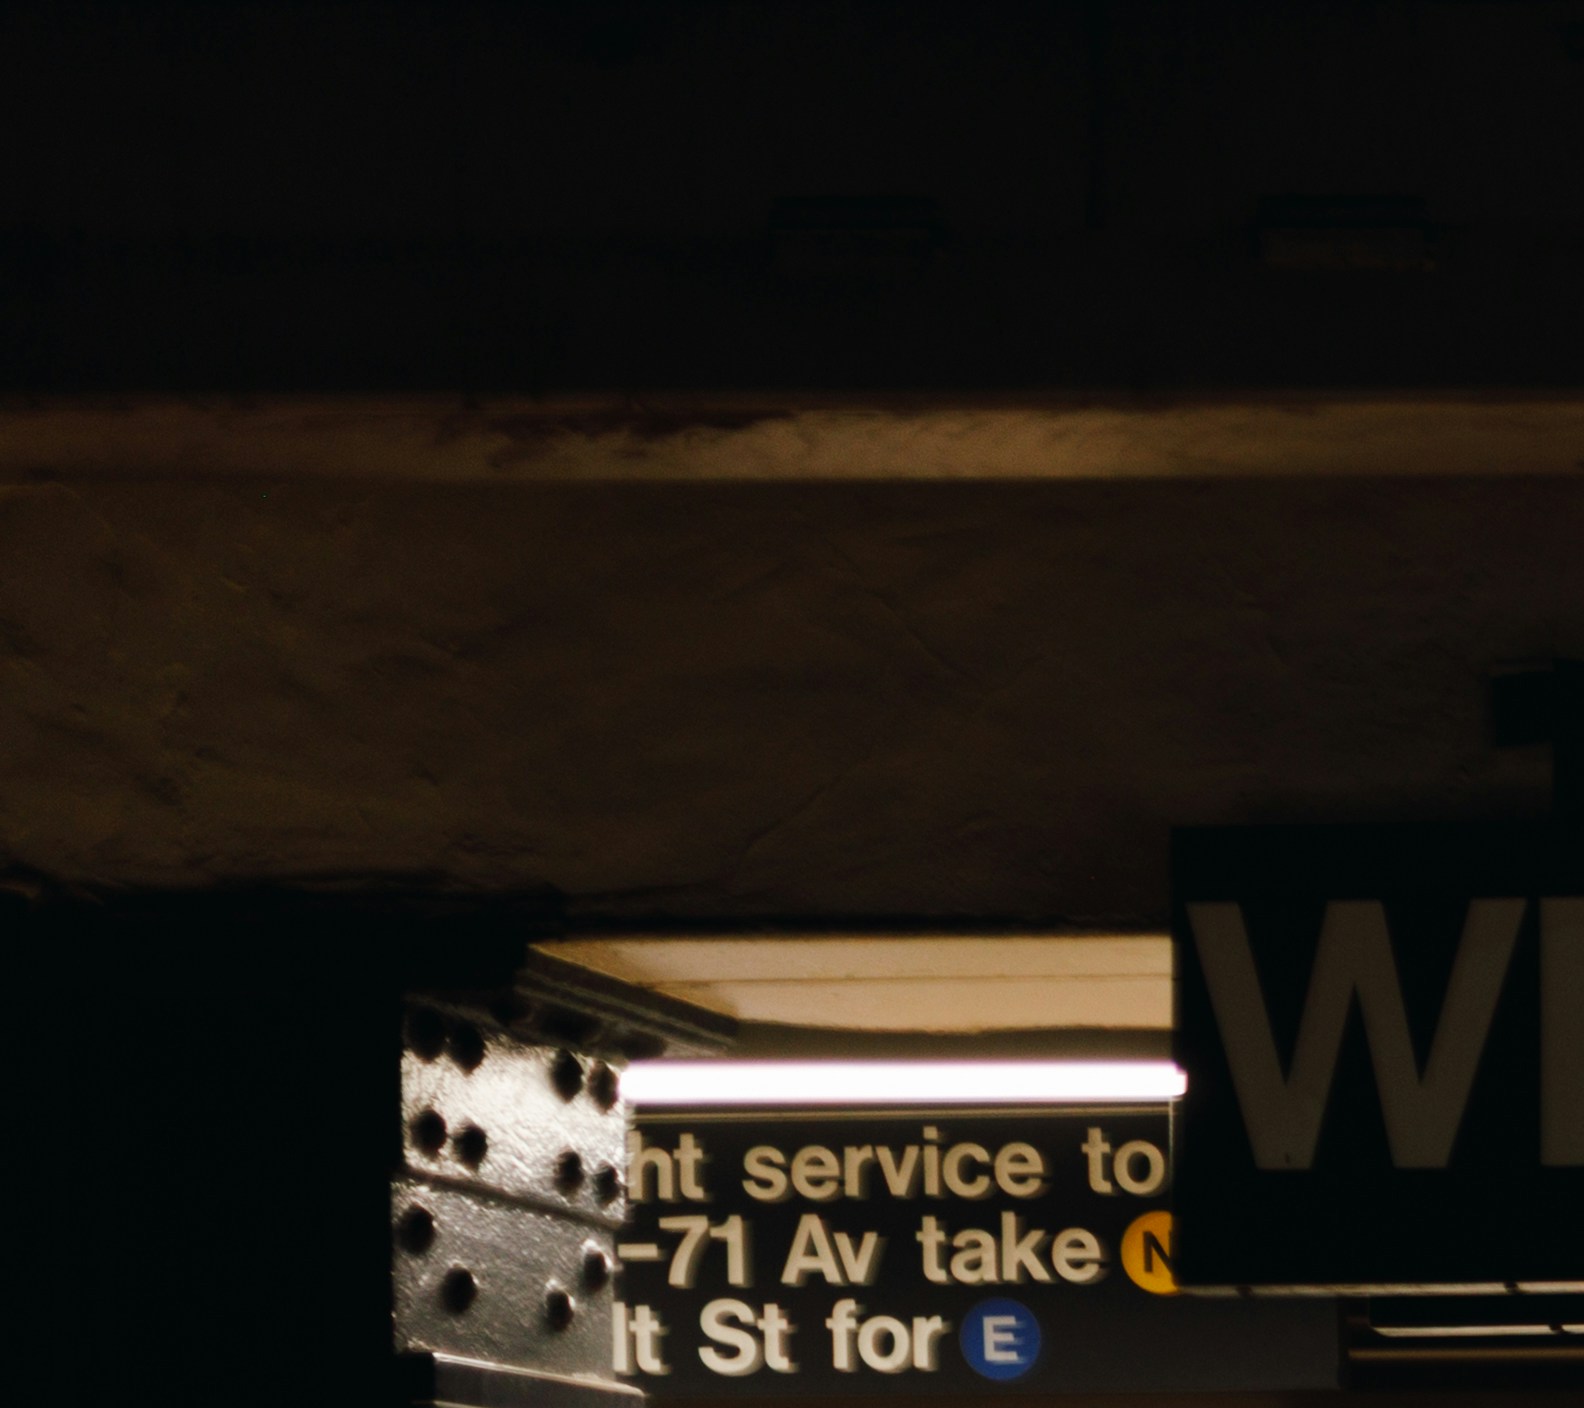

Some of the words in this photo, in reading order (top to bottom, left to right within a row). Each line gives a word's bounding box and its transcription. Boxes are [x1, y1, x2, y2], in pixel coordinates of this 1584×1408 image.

[741, 1126, 1048, 1201] service
[1081, 1126, 1168, 1199] to
[781, 1212, 884, 1287] Av
[915, 1210, 1109, 1287] take
[697, 1298, 800, 1377] St
[825, 1298, 951, 1376] for
[981, 1315, 1024, 1364] E
